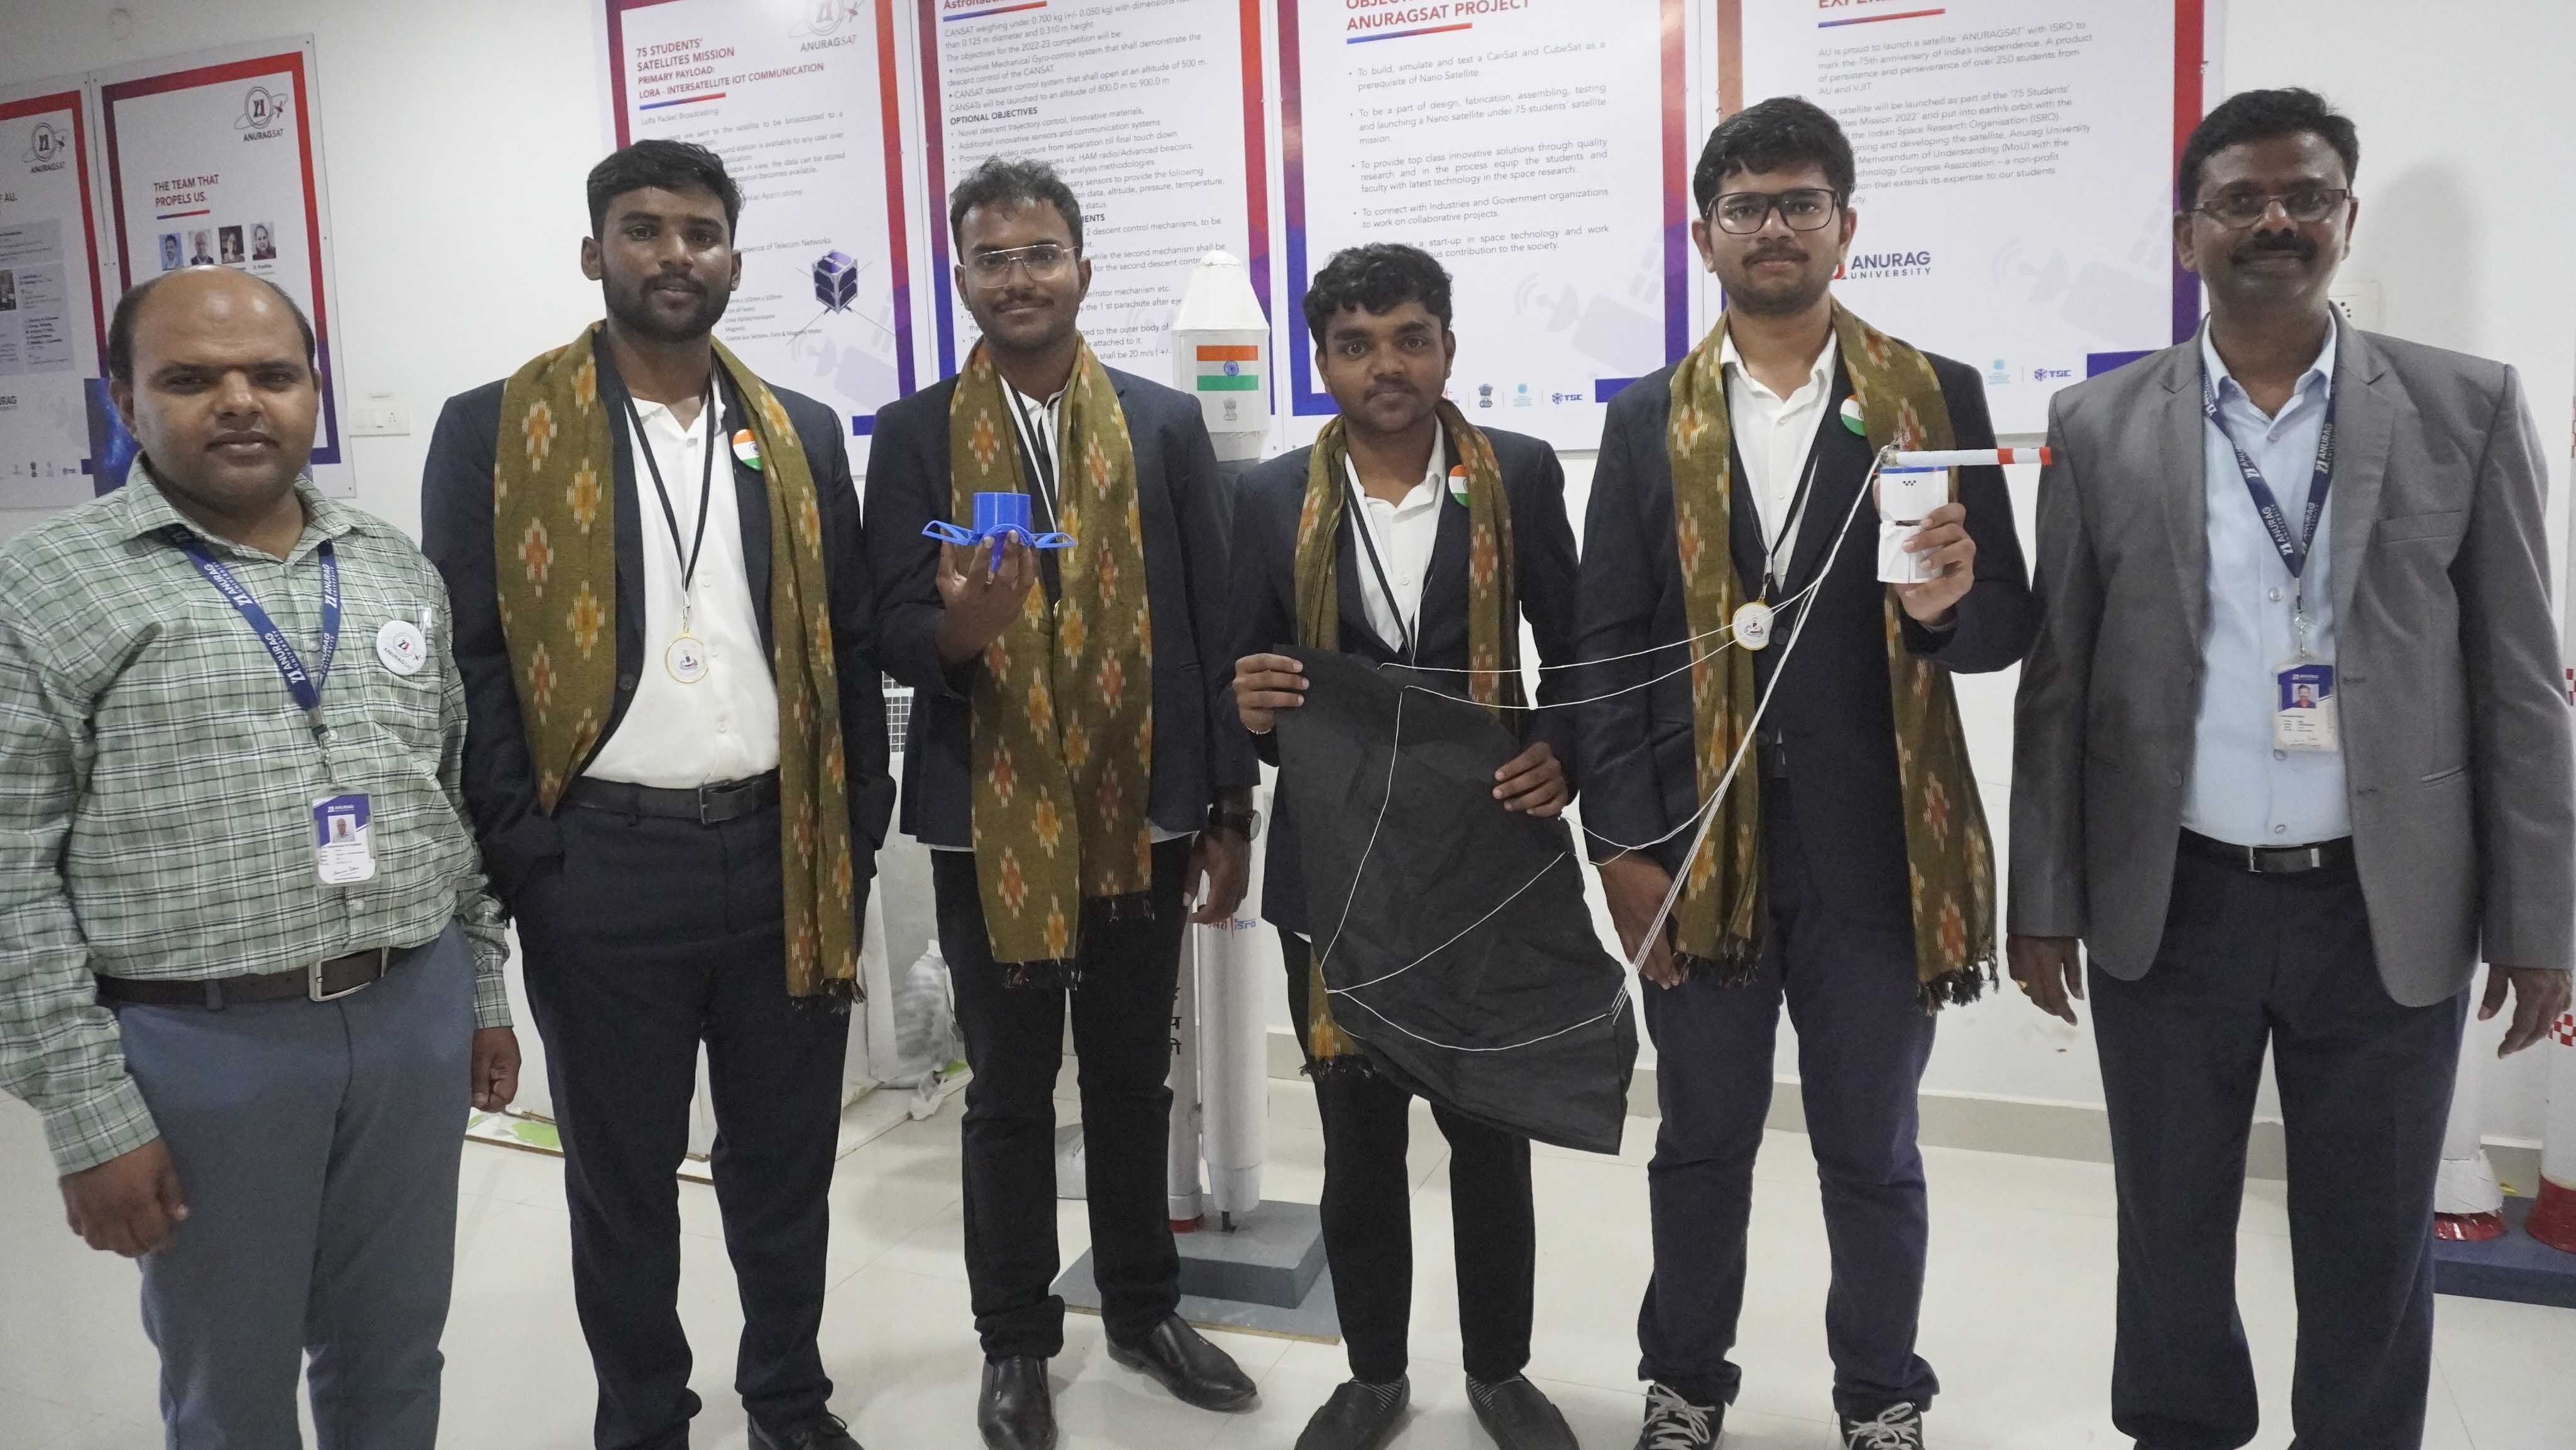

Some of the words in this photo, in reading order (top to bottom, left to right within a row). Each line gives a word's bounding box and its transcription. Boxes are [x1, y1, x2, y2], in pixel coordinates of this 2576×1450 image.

[1346, 4, 1449, 30] ANURAGSAT
[1455, 0, 1528, 16] PROJECT
[636, 47, 647, 57] 75
[800, 34, 857, 52] ANURAGSAT
[637, 54, 689, 72] SATELLITES
[693, 47, 734, 62] MISSION
[638, 72, 673, 84] PRIMARY
[675, 66, 714, 79] PAYLOAD:
[639, 88, 660, 99] LORA
[667, 77, 730, 94] INTERSATELLITE
[732, 74, 746, 84] IOT
[748, 63, 823, 82] COMMUNICATION
[950, 114, 989, 125] OPTIONAL
[991, 106, 1037, 119] OBJECTIVES
[958, 128, 978, 136] Novel
[979, 125, 1007, 135] descent
[1008, 121, 1040, 131] trajectory
[1071, 113, 1106, 122] Innovative
[243, 128, 283, 141] ANURAGSAT
[959, 138, 993, 149] Additional
[995, 136, 1029, 144] innovative
[1032, 132, 1057, 140] sensors
[1059, 128, 1072, 137] and
[1074, 123, 1129, 135] communication
[1131, 119, 1160, 130] systems
[1360, 160, 1370, 169] To
[1373, 157, 1404, 170] provide
[1408, 157, 1423, 165] top
[1426, 153, 1445, 162] class
[1450, 150, 1492, 159] innovative
[1496, 146, 1534, 155] solutions
[1538, 141, 1573, 152] through
[1577, 138, 1607, 150] quality
[1361, 170, 1394, 180] research
[1401, 167, 1416, 177] and
[1435, 165, 1448, 174] the
[1455, 162, 1488, 174] process
[1494, 160, 1519, 169] equip
[1525, 156, 1539, 165] the
[1546, 153, 1584, 163] students
[1590, 150, 1607, 158] and
[153, 181, 170, 192] THE
[171, 177, 195, 189] TEAM
[197, 174, 219, 185] THAT
[1086, 177, 1112, 185] sensors
[1124, 172, 1152, 184] provide
[1169, 168, 1203, 176] following
[155, 193, 192, 207] PROPELS
[193, 192, 207, 201] US.
[1362, 208, 1372, 216] To
[1374, 206, 1407, 216] connect
[1409, 202, 1426, 211] with
[1429, 201, 1470, 210] Industries
[1473, 197, 1489, 206] and
[1492, 193, 1546, 204] Government
[1549, 189, 1609, 201] organizations
[1373, 218, 1392, 226] work
[1406, 212, 1461, 224] collaborative
[1086, 228, 1091, 236] 2
[1093, 226, 1121, 235] descent
[1123, 223, 1148, 233] control
[1429, 238, 1461, 246] start-up
[1480, 235, 1505, 244] space
[1511, 229, 1559, 240] technology
[1565, 226, 1582, 235] and
[1588, 223, 1609, 233] work
[1089, 252, 1108, 260] while
[1123, 248, 1150, 258] second
[1152, 246, 1194, 255] mechanism
[1196, 243, 1213, 252] shall
[1215, 242, 1226, 250] be
[1445, 246, 1496, 257] contribution
[1511, 243, 1524, 252] the
[1120, 261, 1146, 270] second
[1147, 258, 1177, 268] descent
[1851, 251, 1931, 270] ANURAG
[1851, 267, 1931, 279] UNIVERSITY
[1114, 300, 1150, 311] parachute
[1152, 297, 1169, 306] after
[1140, 323, 1159, 332] body
[1162, 322, 1172, 331] of
[2318, 423, 2332, 459] ANURAG
[2263, 506, 2284, 543] ANURAG
[204, 563, 238, 595] ANURAG
[322, 563, 333, 594] ANURAG
[265, 633, 294, 670] ANURAG
[272, 630, 299, 668] UNIVERSITY
